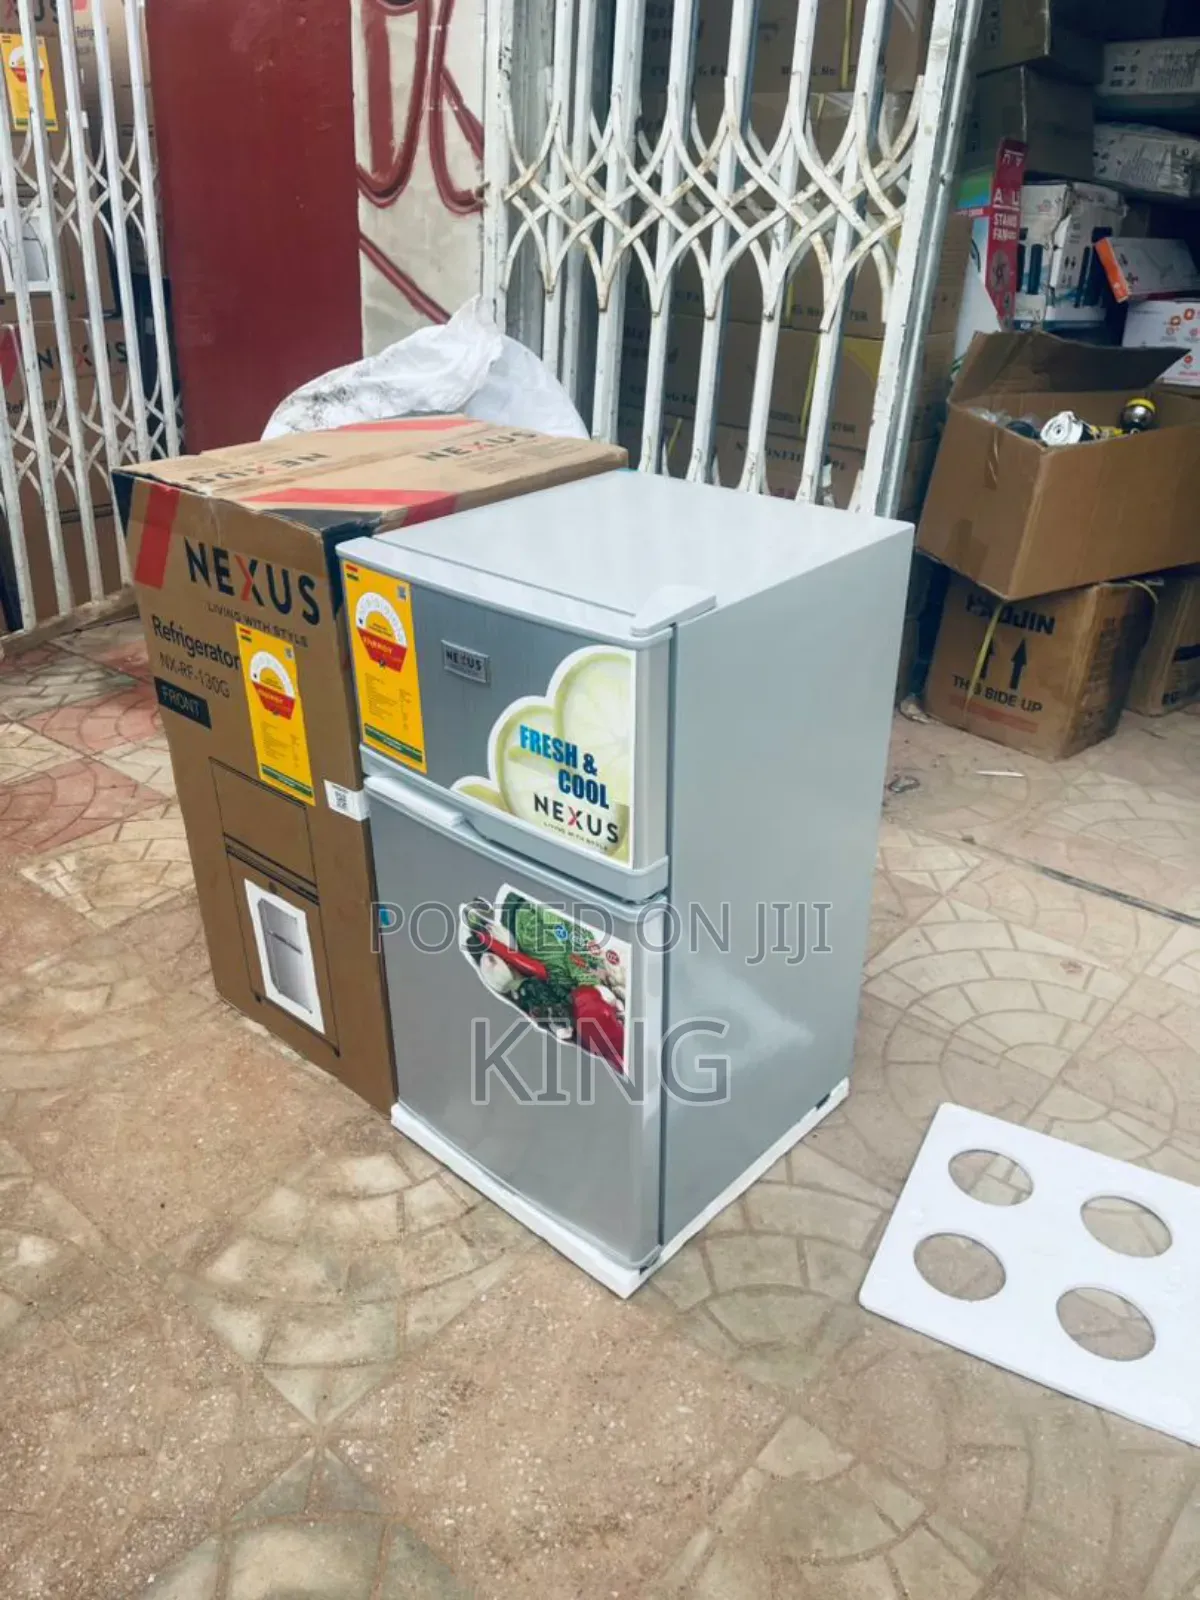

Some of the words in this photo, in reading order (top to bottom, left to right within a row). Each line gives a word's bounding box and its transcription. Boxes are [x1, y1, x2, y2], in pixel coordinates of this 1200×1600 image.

[421, 430, 537, 462] NEXUS
[187, 452, 331, 485] NEXUS
[184, 536, 320, 626] NEXUS
[208, 602, 242, 622] LIVING
[152, 613, 240, 671] Refrigerator
[445, 650, 482, 672] NEXUS
[161, 685, 202, 718] FRONT
[952, 674, 982, 696] THS
[984, 684, 1017, 708] SIDE
[1020, 698, 1043, 713] UP
[519, 723, 578, 769] FRESH
[583, 752, 598, 776] &
[558, 768, 610, 809] COOL
[533, 792, 619, 844] NEXUS
